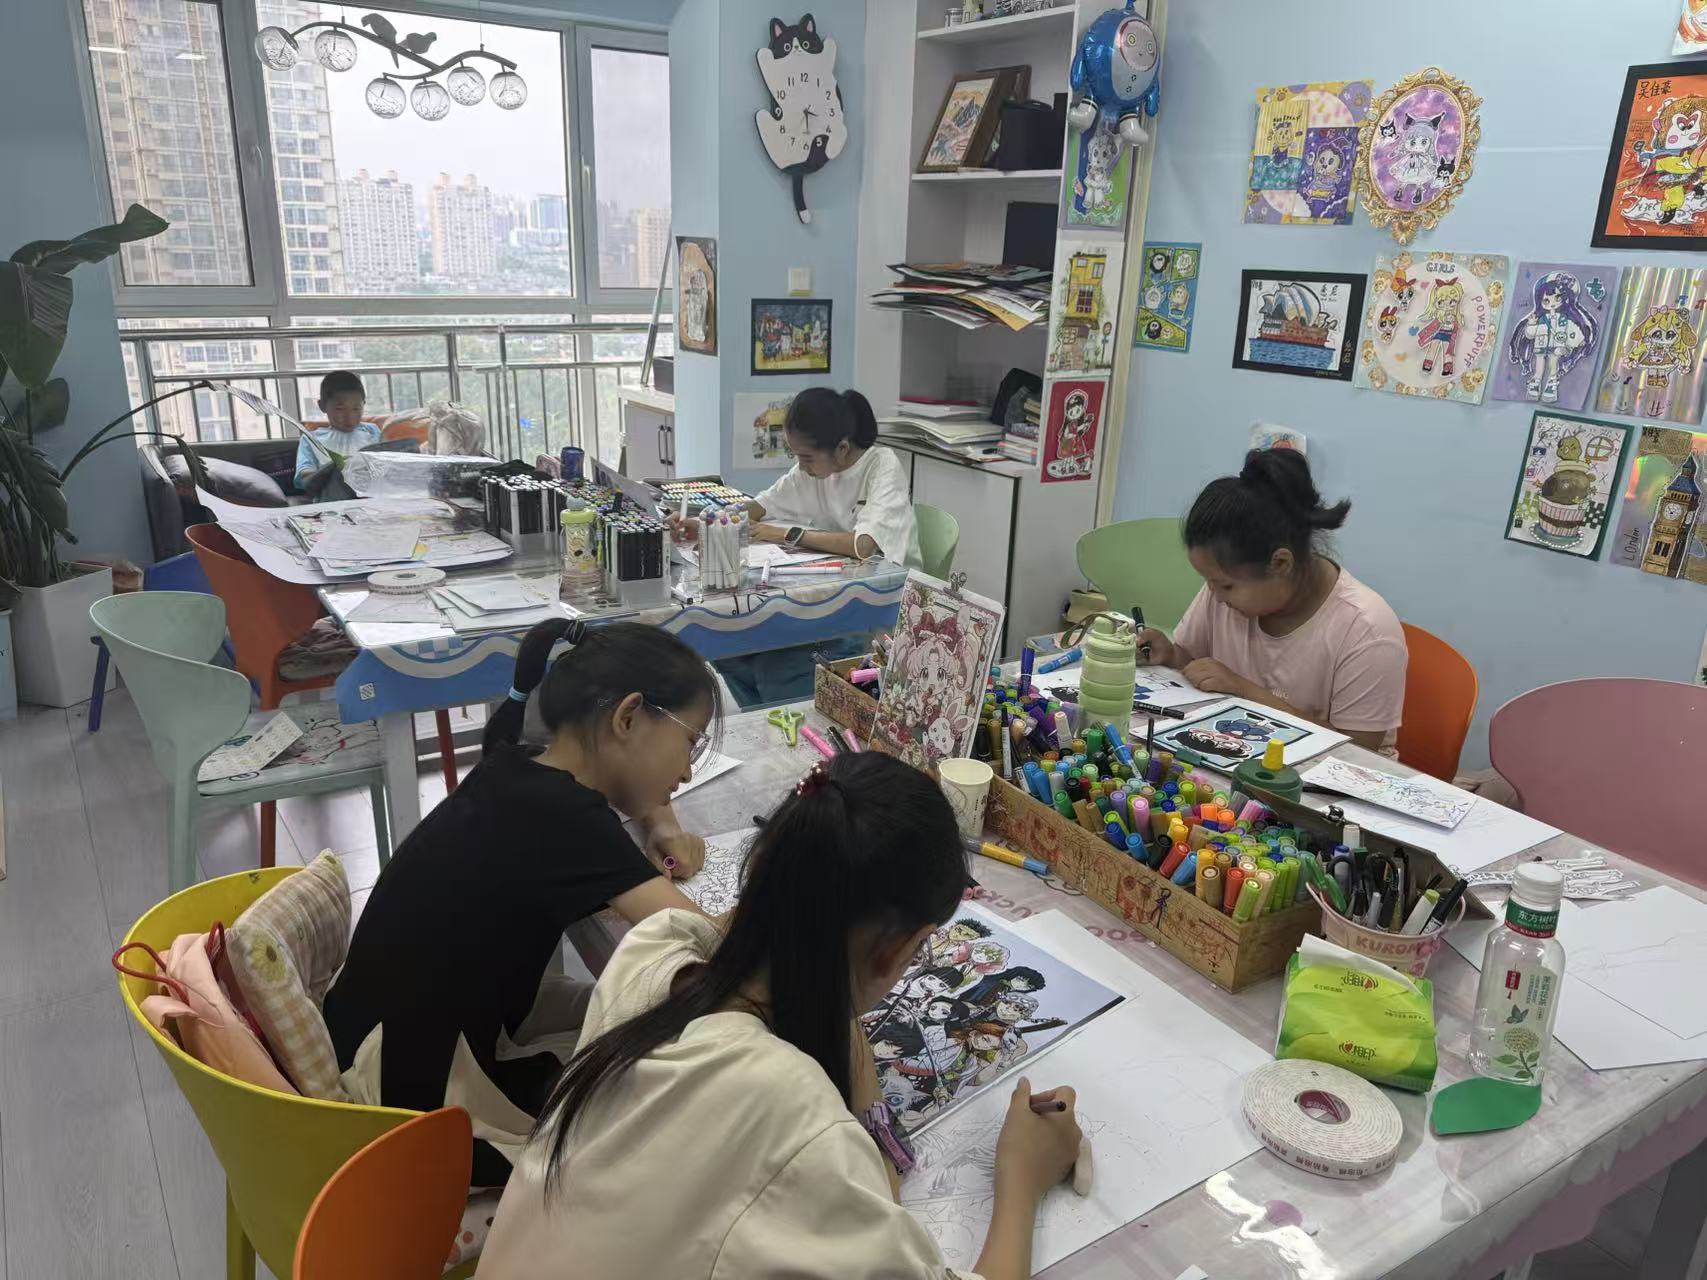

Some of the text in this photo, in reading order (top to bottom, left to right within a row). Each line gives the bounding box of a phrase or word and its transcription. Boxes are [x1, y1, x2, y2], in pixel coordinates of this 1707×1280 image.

[787, 77, 796, 86] 11
[800, 73, 809, 83] 12
[816, 78, 820, 88] 1
[777, 90, 786, 100] 10
[826, 91, 832, 100] 2
[776, 107, 783, 116] 9
[829, 108, 835, 117] 3
[780, 125, 786, 134] 8
[826, 125, 832, 134] 4
[790, 137, 795, 146] 7
[816, 138, 823, 147] 5
[803, 142, 809, 151] 6
[1426, 262, 1456, 273] GIRLS
[1463, 295, 1486, 368] POWERPUFF
